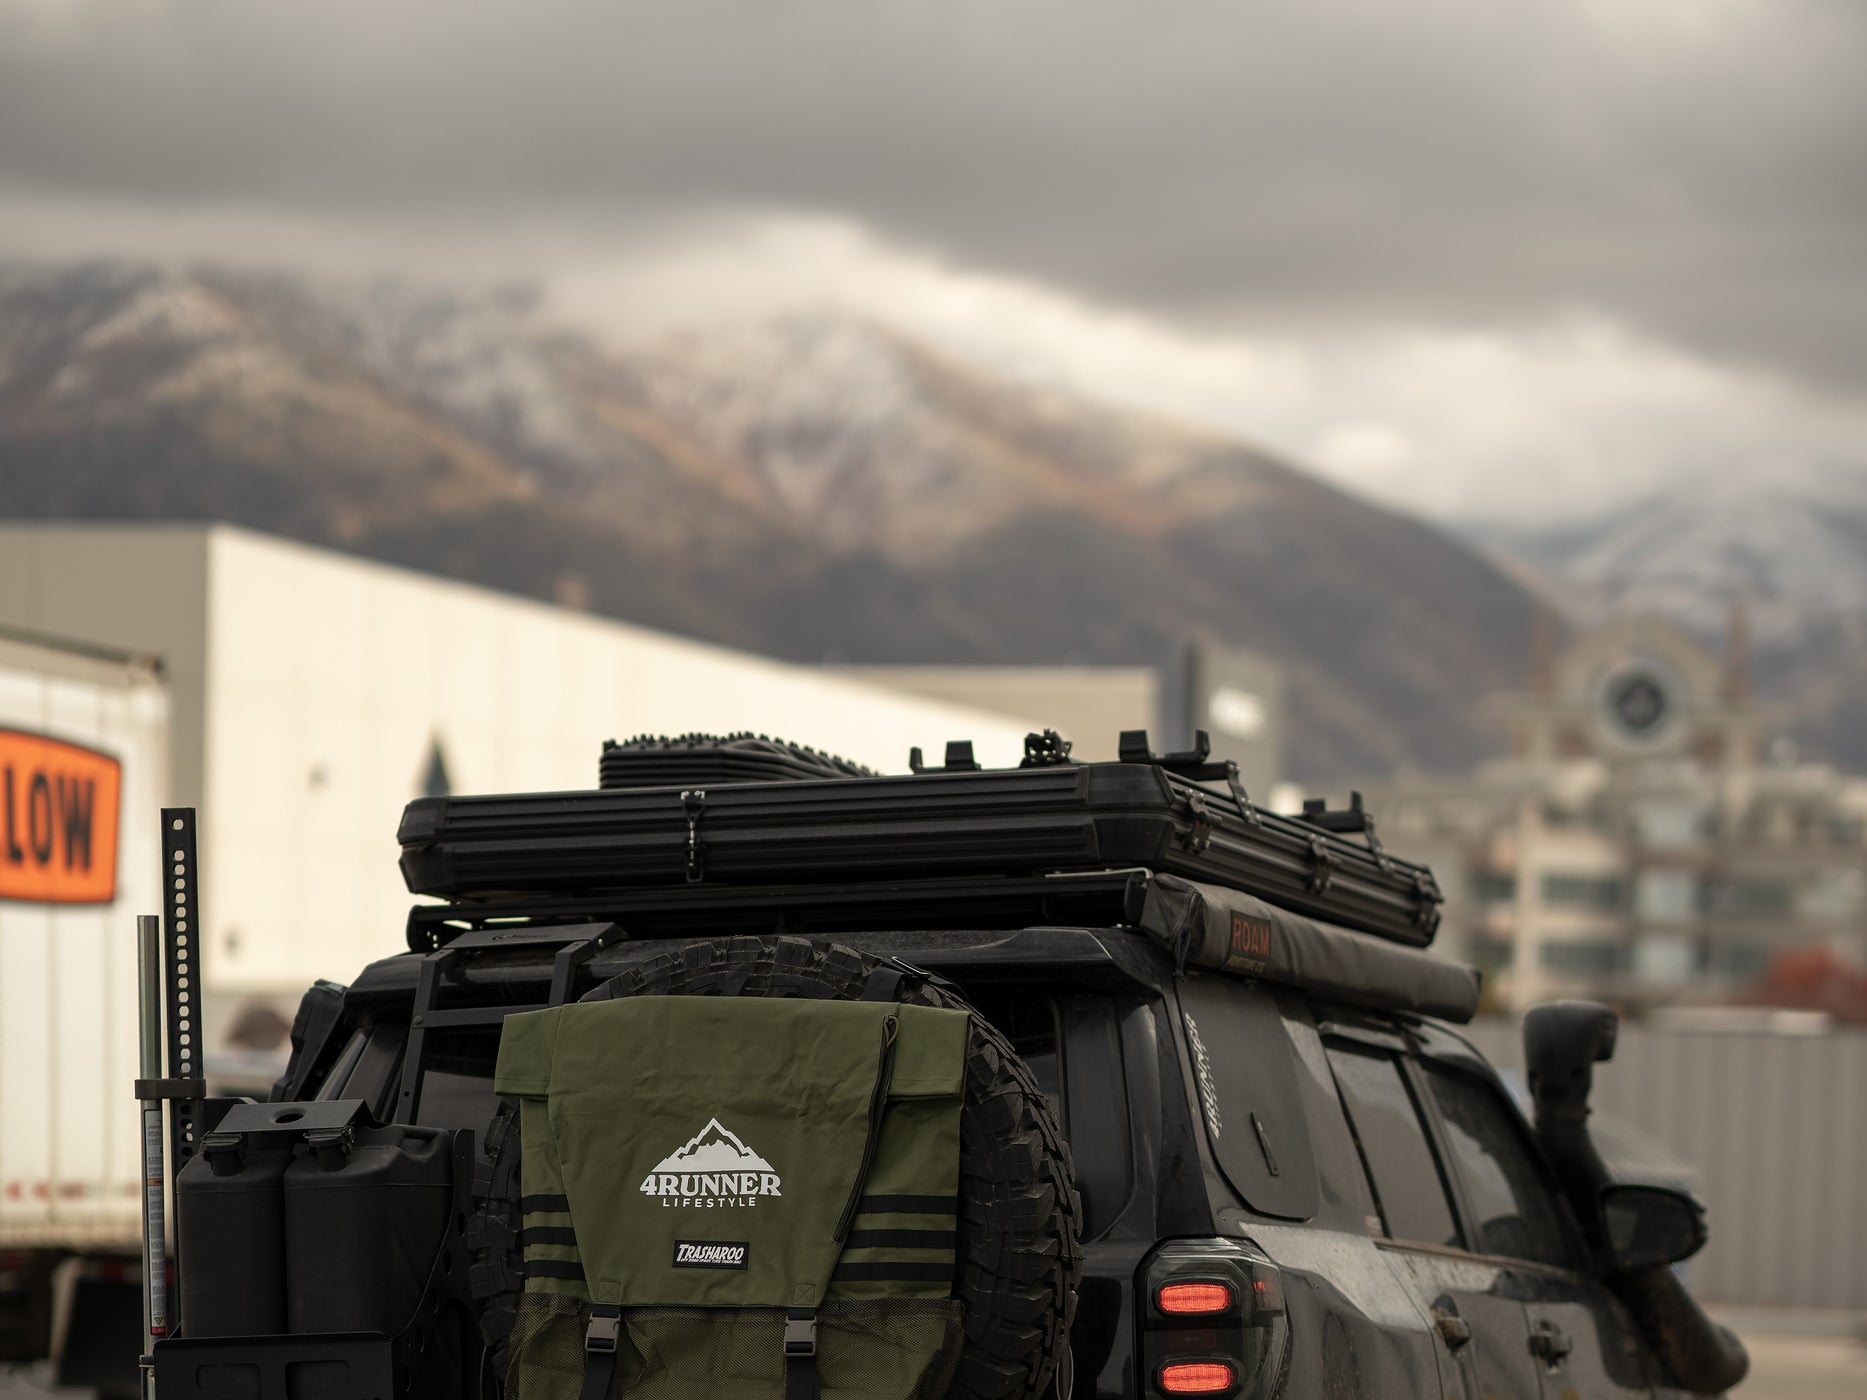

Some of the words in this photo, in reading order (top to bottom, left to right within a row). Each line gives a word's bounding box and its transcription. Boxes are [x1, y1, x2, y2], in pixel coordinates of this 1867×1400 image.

[6, 766, 95, 871] LOW
[1231, 917, 1270, 957] ROAM
[1185, 1012, 1220, 1140] 4RUNNER
[639, 1173, 782, 1196] 4RUNNER
[662, 1197, 756, 1208] LIFESTYLE
[676, 1243, 745, 1262] TRASHAROO
